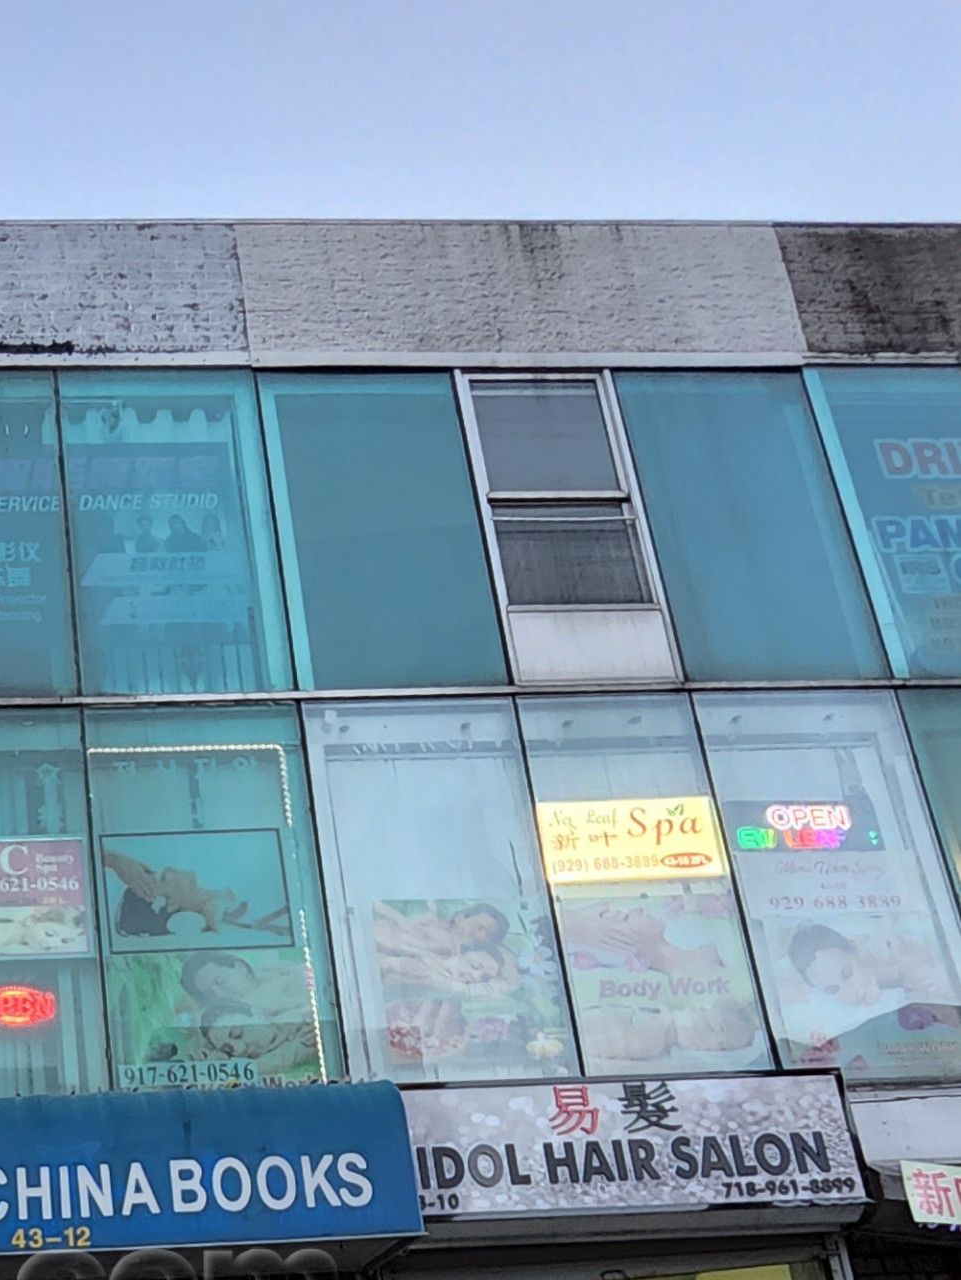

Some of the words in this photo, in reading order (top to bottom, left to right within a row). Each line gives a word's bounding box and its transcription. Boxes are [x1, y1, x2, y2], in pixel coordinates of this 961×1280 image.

[79, 494, 143, 512] DANCE
[149, 493, 219, 511] STUDIO
[626, 806, 702, 846] Spa
[765, 804, 853, 830] OPEN
[551, 859, 590, 875] (929)
[599, 977, 662, 1001] Body
[669, 974, 732, 996] Work
[122, 1061, 256, 1087] 917-621-0546
[549, 1078, 683, 1137] 易髮
[416, 1143, 531, 1190] IDOL
[542, 1136, 662, 1184] HAIR
[669, 1130, 834, 1179] SALON
[172, 1152, 374, 1212] BOOKS
[11, 1225, 92, 1249] 43-12
